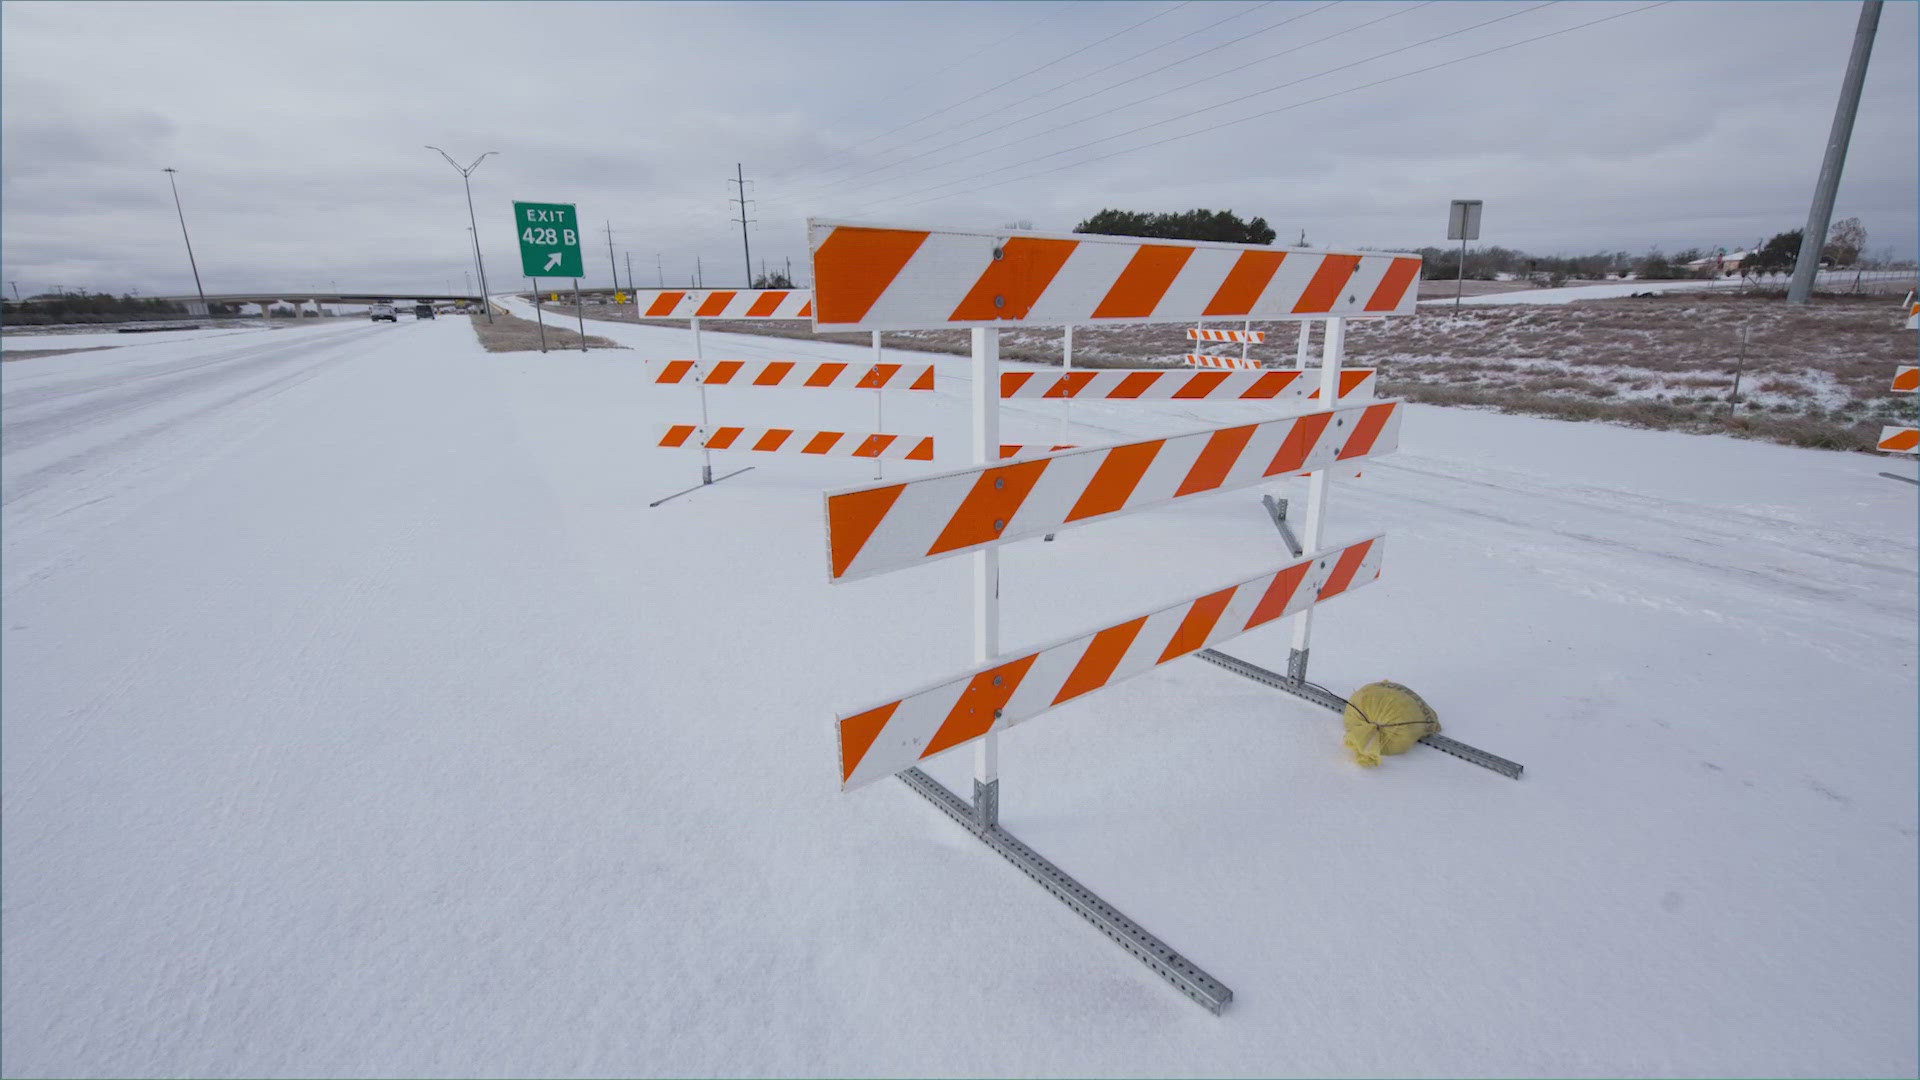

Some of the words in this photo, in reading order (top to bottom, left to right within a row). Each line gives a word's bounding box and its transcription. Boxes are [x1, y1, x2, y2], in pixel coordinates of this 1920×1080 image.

[526, 208, 565, 222] EXIT
[522, 227, 558, 245] 428
[563, 228, 577, 246] B
